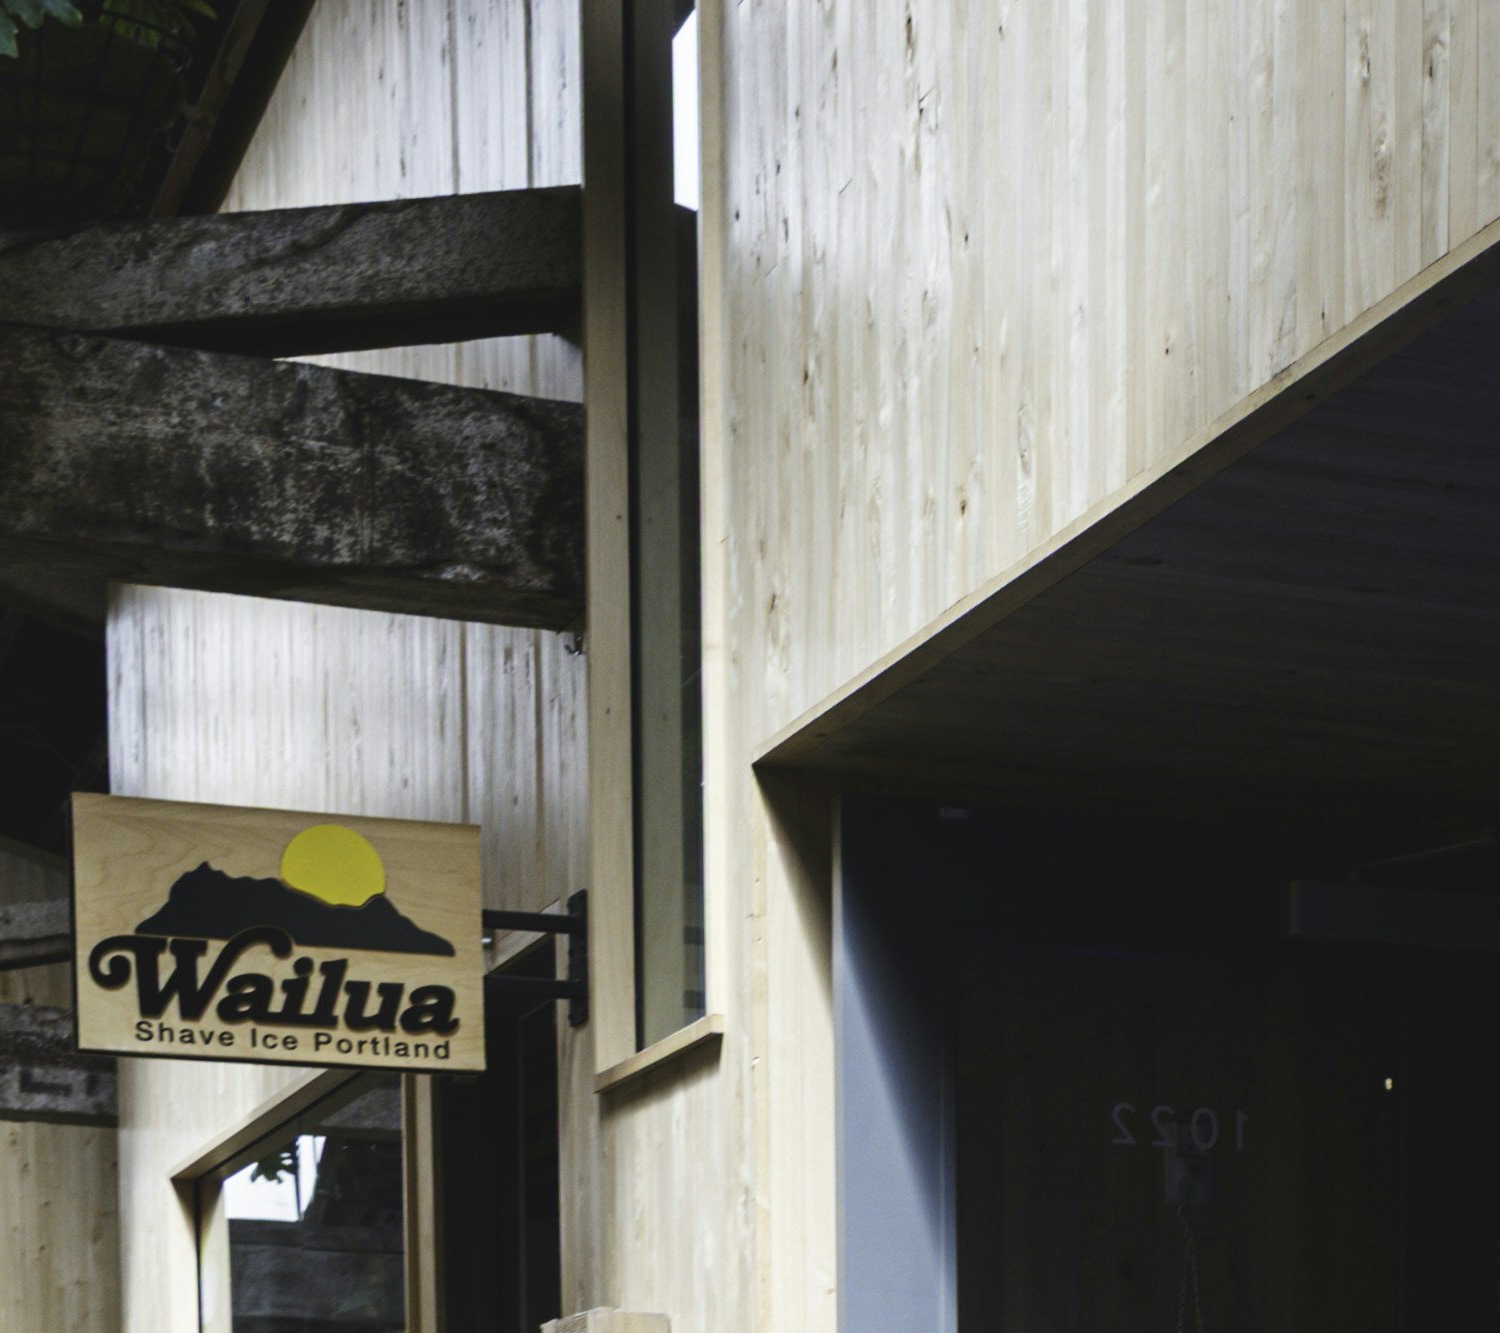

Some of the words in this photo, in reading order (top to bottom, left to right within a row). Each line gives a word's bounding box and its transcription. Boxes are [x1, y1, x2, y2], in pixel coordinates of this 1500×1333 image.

[88, 925, 460, 1038] Wailua
[134, 1020, 236, 1046] Shave
[250, 1028, 298, 1051] Ice
[314, 1033, 452, 1060] Portland
